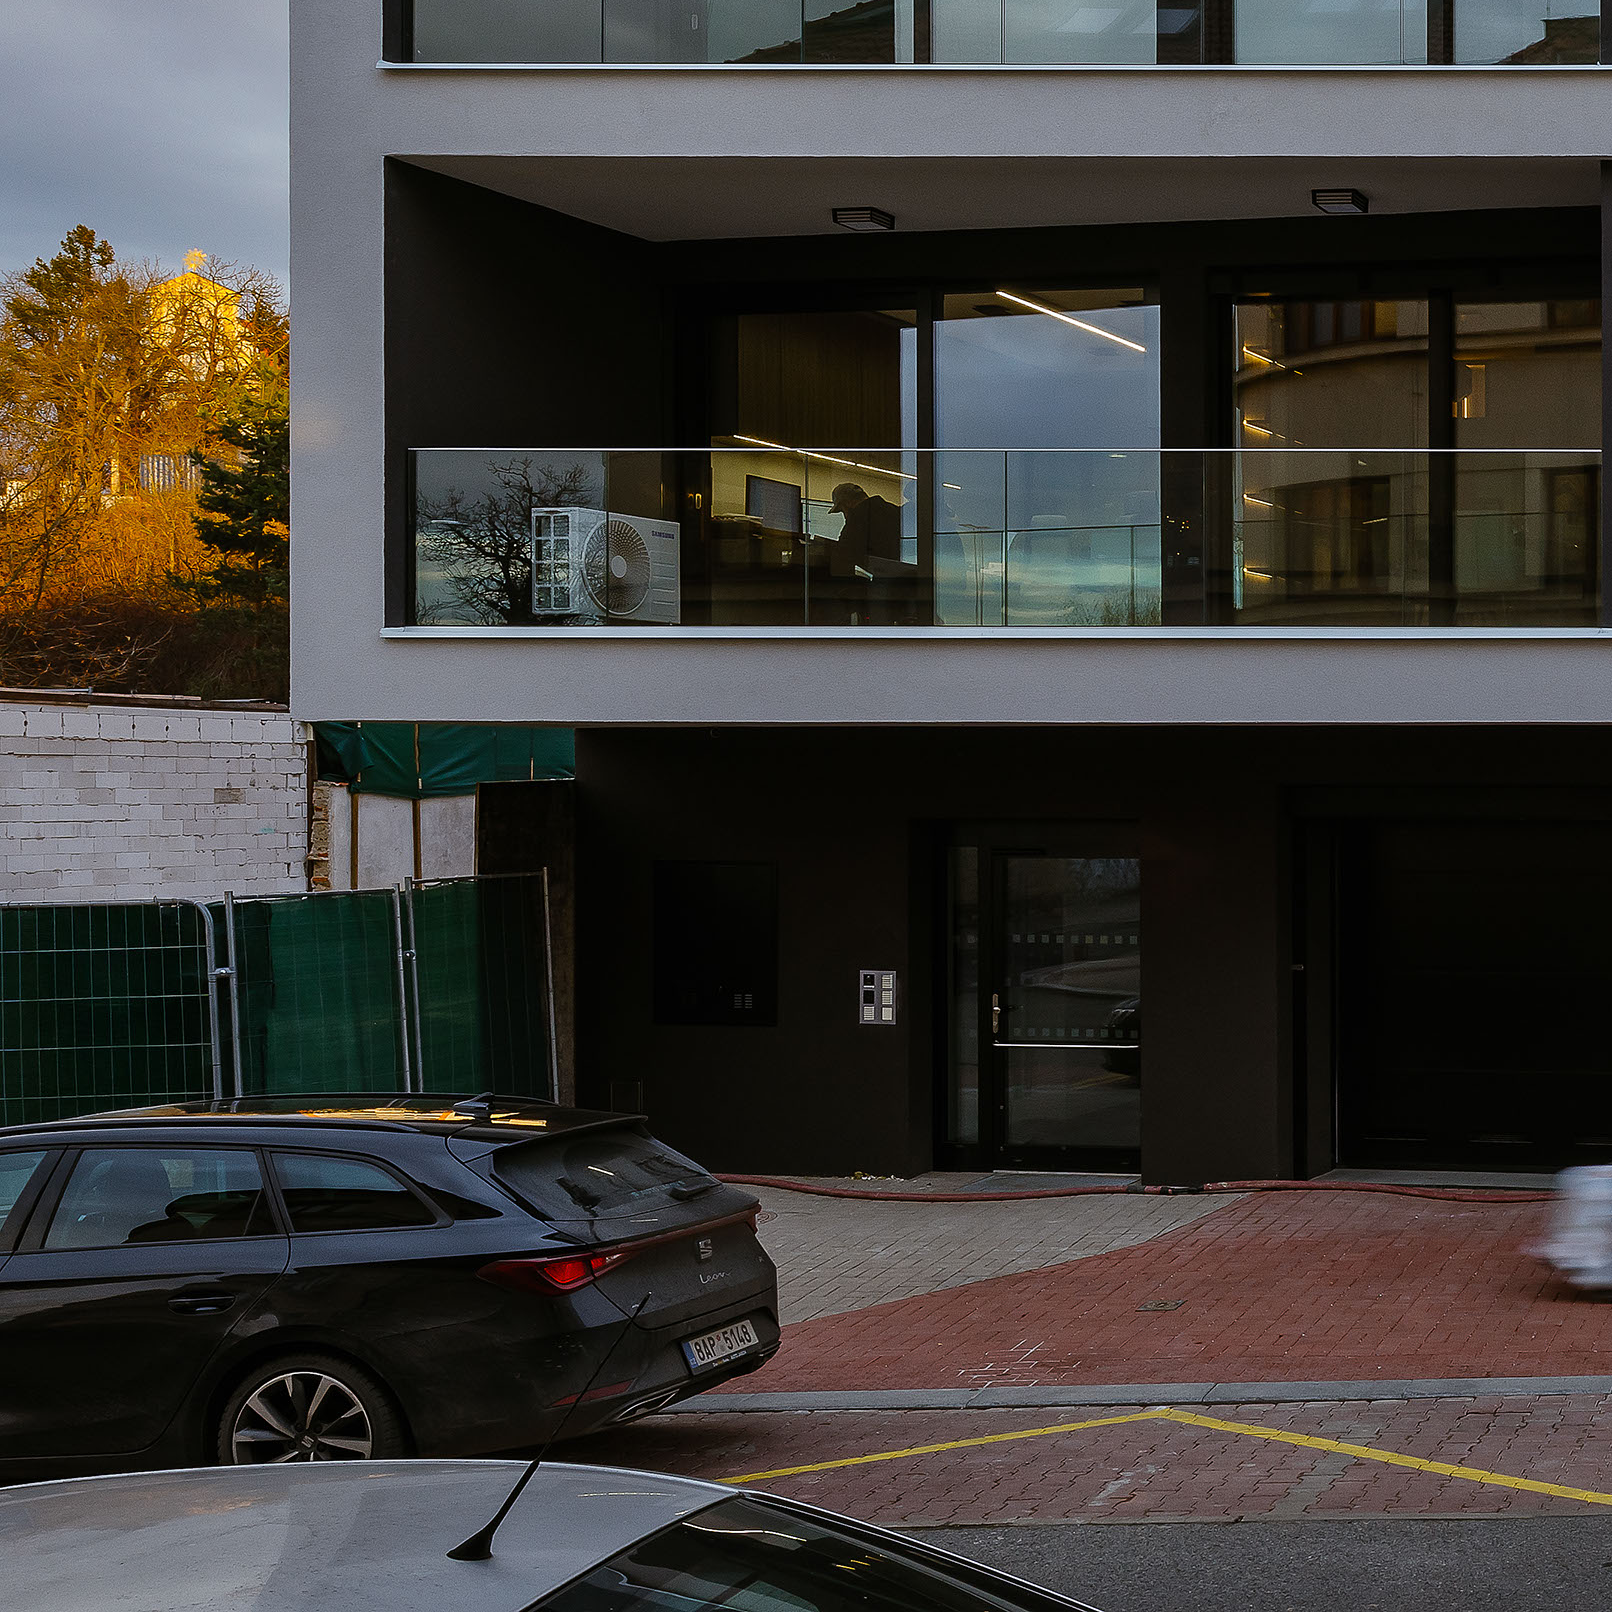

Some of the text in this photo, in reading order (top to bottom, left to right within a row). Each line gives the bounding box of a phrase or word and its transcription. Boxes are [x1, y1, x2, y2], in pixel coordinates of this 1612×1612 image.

[651, 530, 675, 539] SAMSUNG
[699, 1268, 733, 1284] Leon
[693, 1338, 718, 1362] 8AP
[722, 1324, 752, 1351] 5148
